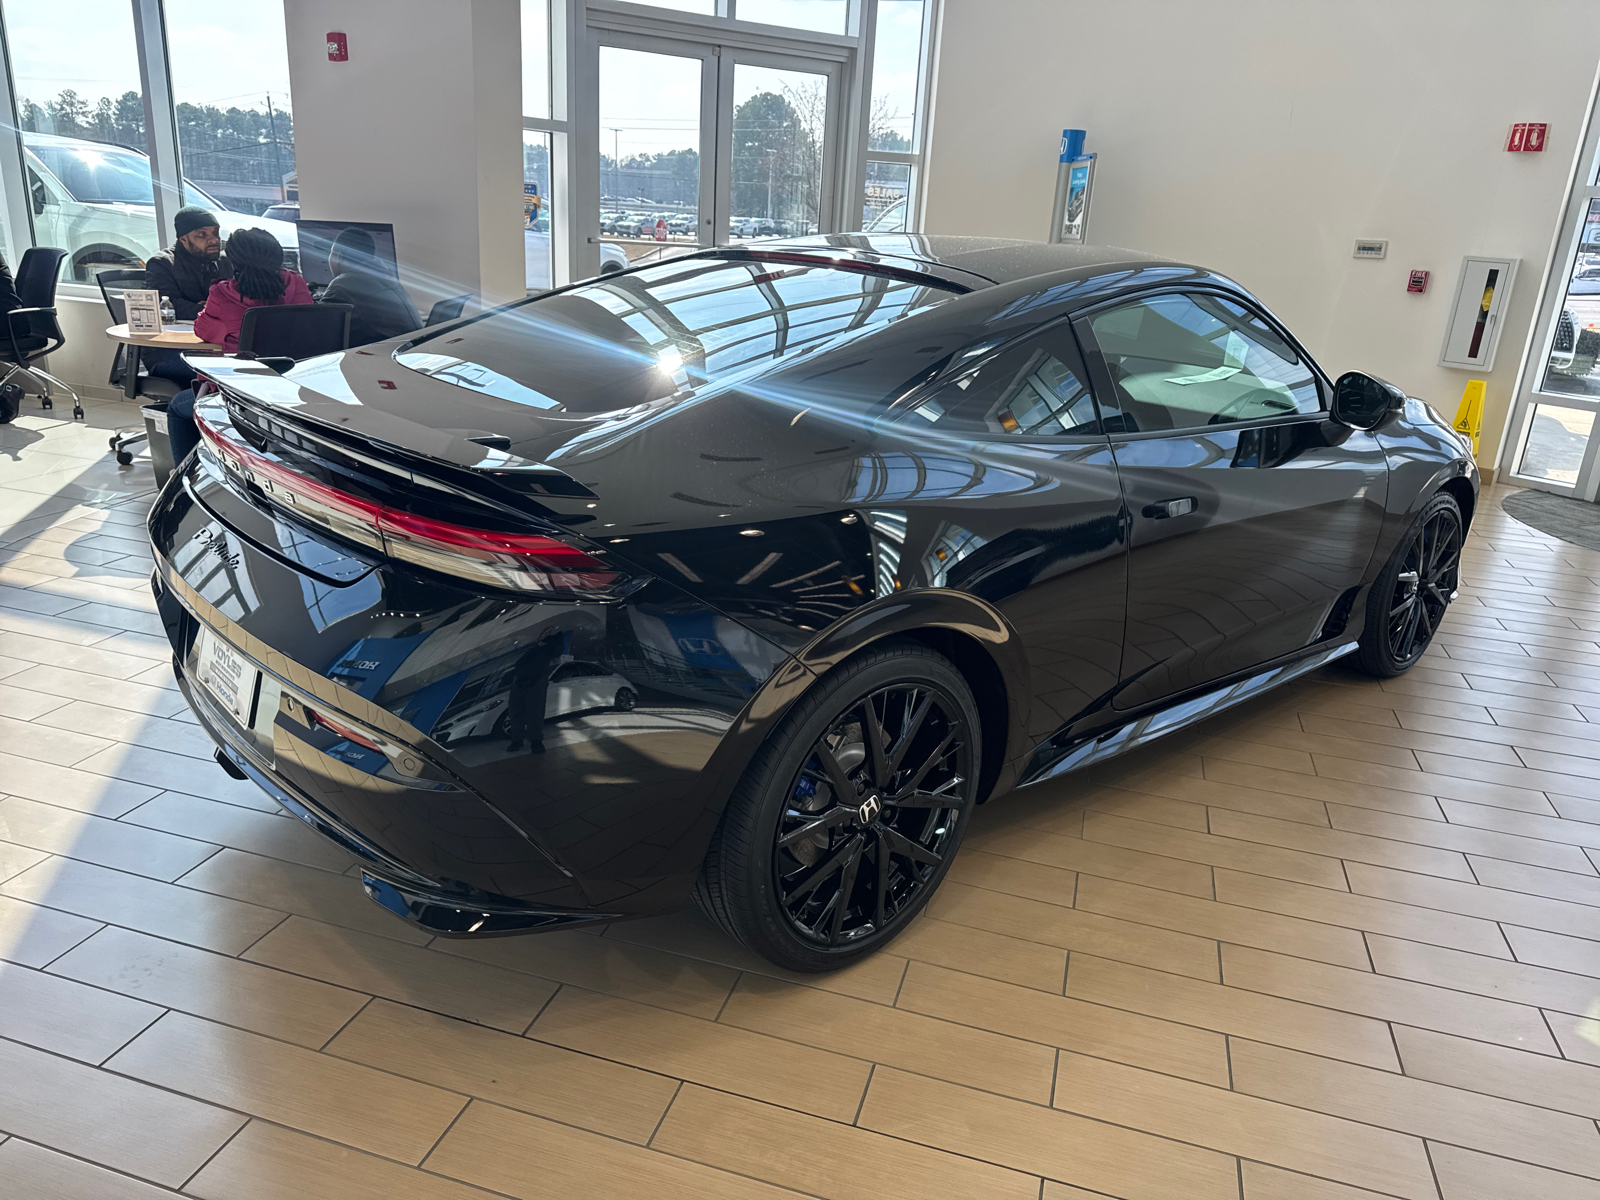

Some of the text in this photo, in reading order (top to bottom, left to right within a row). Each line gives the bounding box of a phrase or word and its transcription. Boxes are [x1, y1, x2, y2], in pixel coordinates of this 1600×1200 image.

[655, 227, 667, 239] STOP
[212, 641, 242, 679] VOYLES
[216, 681, 235, 706] Honda
